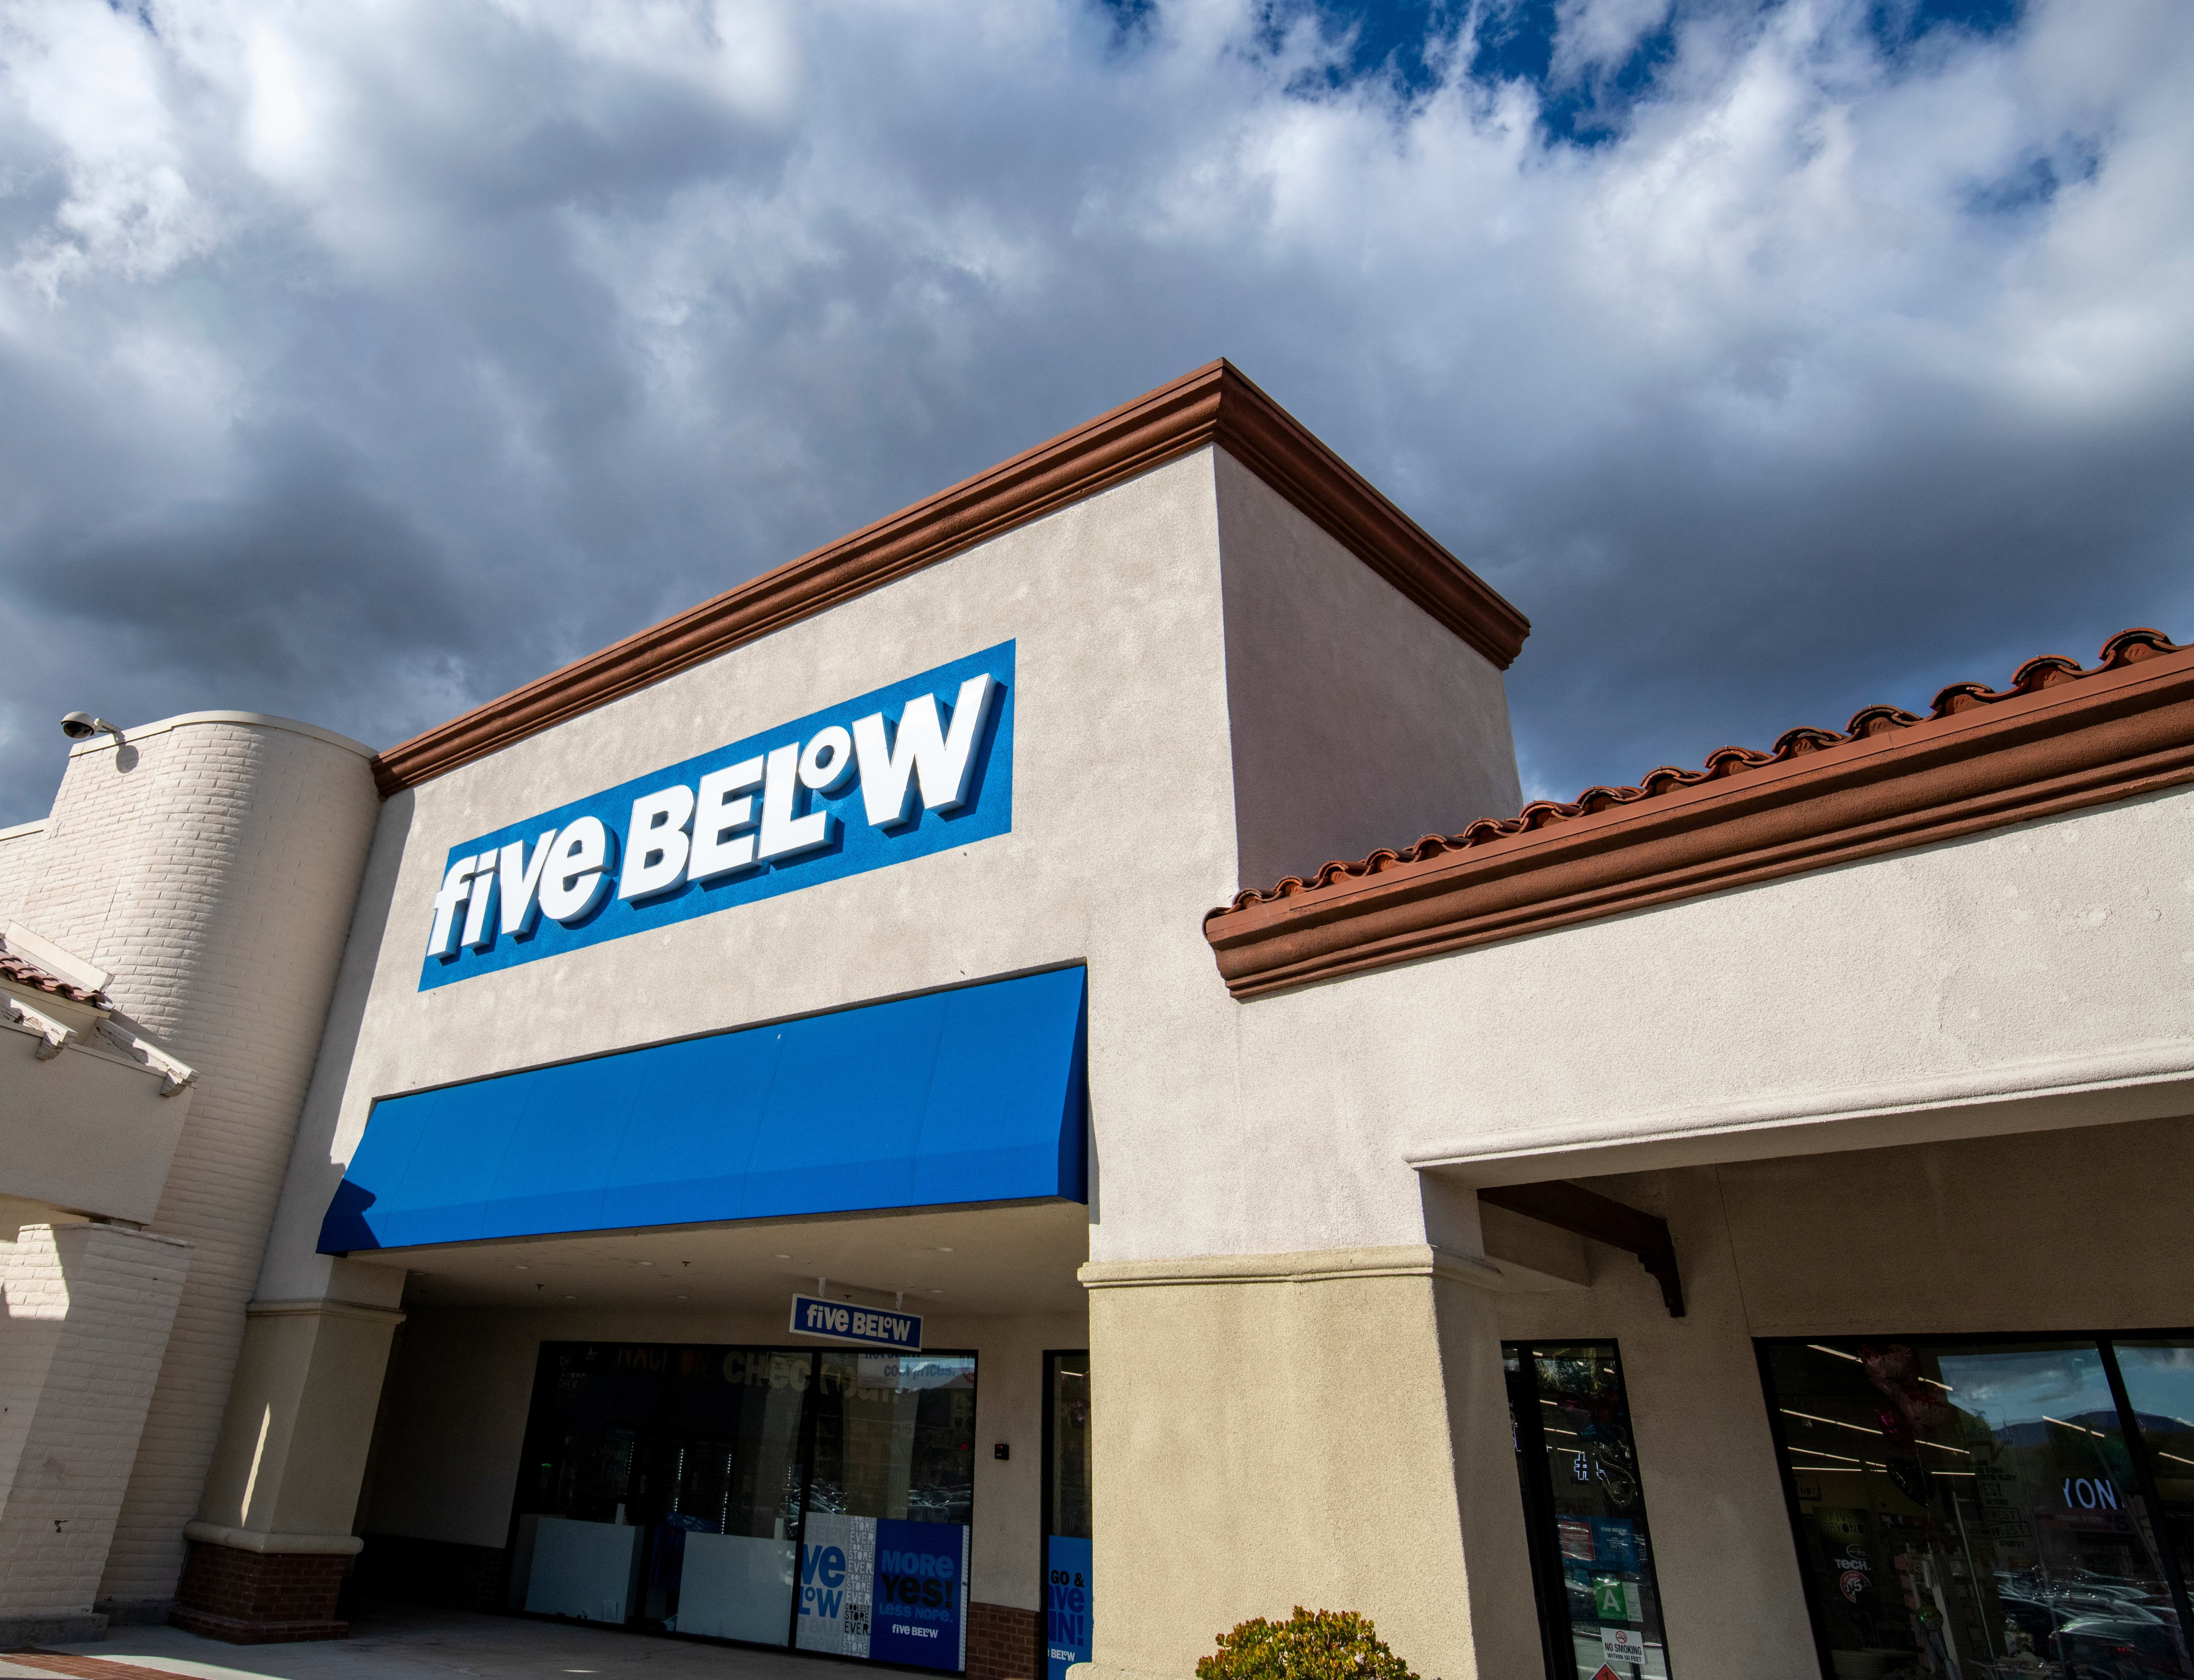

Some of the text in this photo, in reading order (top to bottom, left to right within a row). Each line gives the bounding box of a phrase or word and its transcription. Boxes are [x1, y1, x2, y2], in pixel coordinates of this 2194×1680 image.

[426, 673, 996, 960] five BELOW
[807, 1304, 911, 1341] five BELOW
[851, 1522, 874, 1533] STORE
[850, 1532, 875, 1544] EVER.
[849, 1544, 873, 1552] COOLEST
[848, 1551, 872, 1562] STORE
[848, 1561, 874, 1574] EVER.
[847, 1574, 872, 1582] COOLEST
[1051, 1569, 1070, 1586] GO
[846, 1581, 871, 1592] STORE
[846, 1591, 872, 1605] EVER.
[1603, 1589, 1621, 1612] A
[845, 1603, 869, 1613] COOLEST
[844, 1611, 868, 1622] STORE
[844, 1621, 871, 1635] EVER.
[892, 1624, 938, 1639] five BELOW
[843, 1634, 868, 1643] COOLEST
[843, 1642, 867, 1653] STORE
[1604, 1642, 1642, 1655] NO SMOKING
[1051, 1648, 1075, 1662] BELOW
